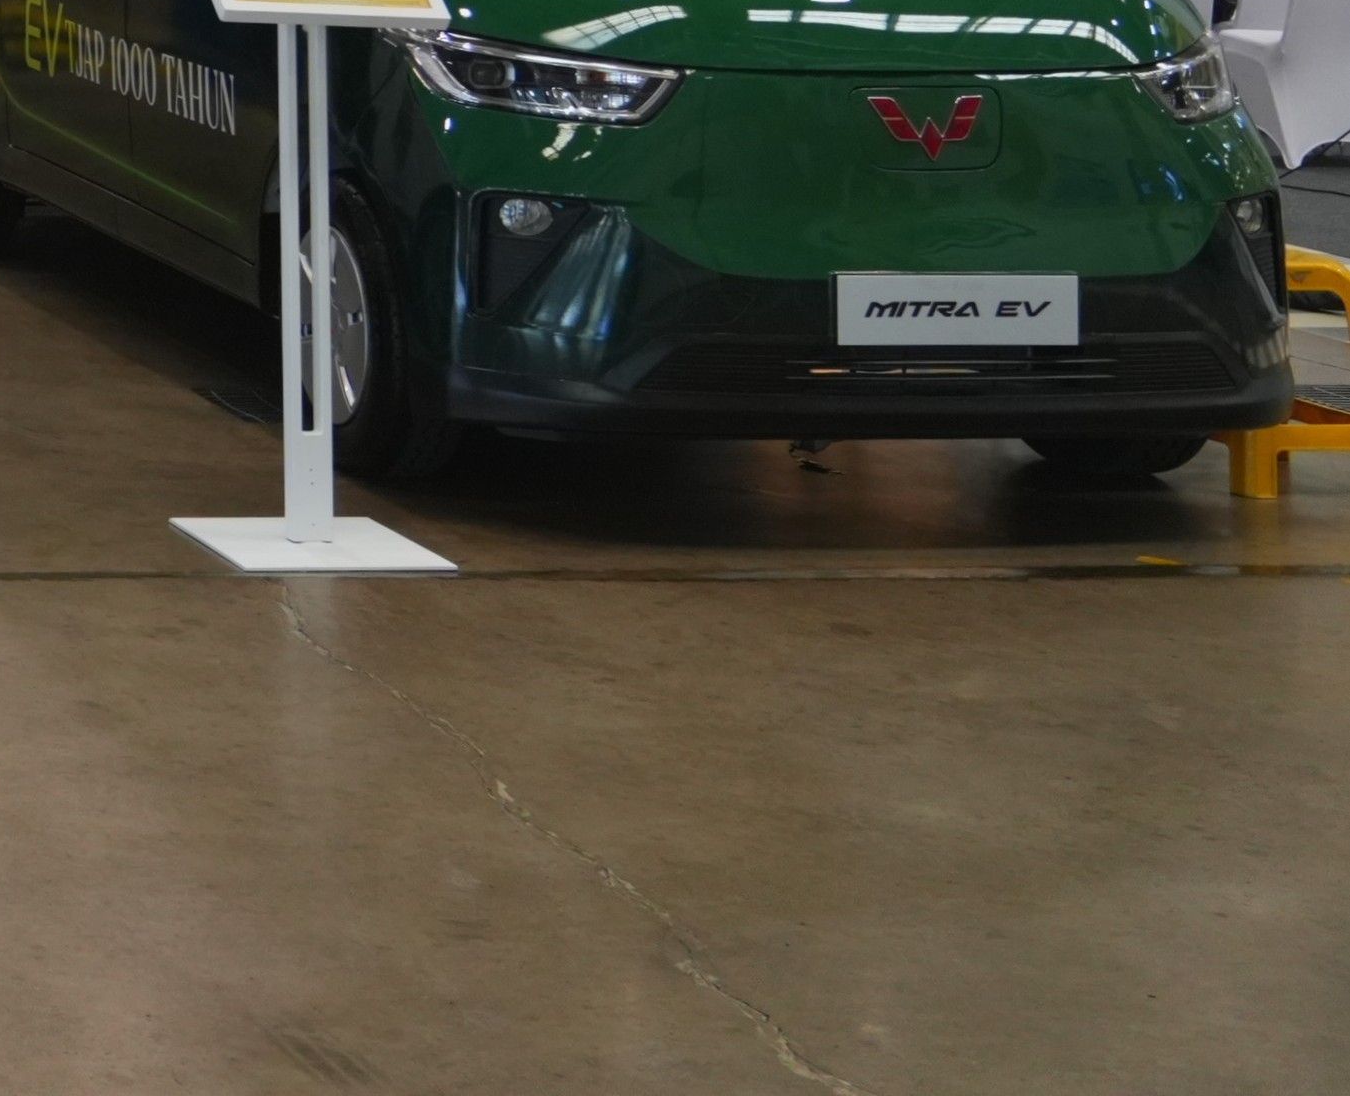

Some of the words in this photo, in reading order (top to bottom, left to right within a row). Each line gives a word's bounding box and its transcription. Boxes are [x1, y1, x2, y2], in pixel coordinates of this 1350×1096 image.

[64, 19, 105, 85] TJAP
[109, 35, 158, 106] 1000
[161, 53, 236, 136] TAHUN
[864, 300, 980, 318] MITRA
[995, 300, 1052, 318] EV
